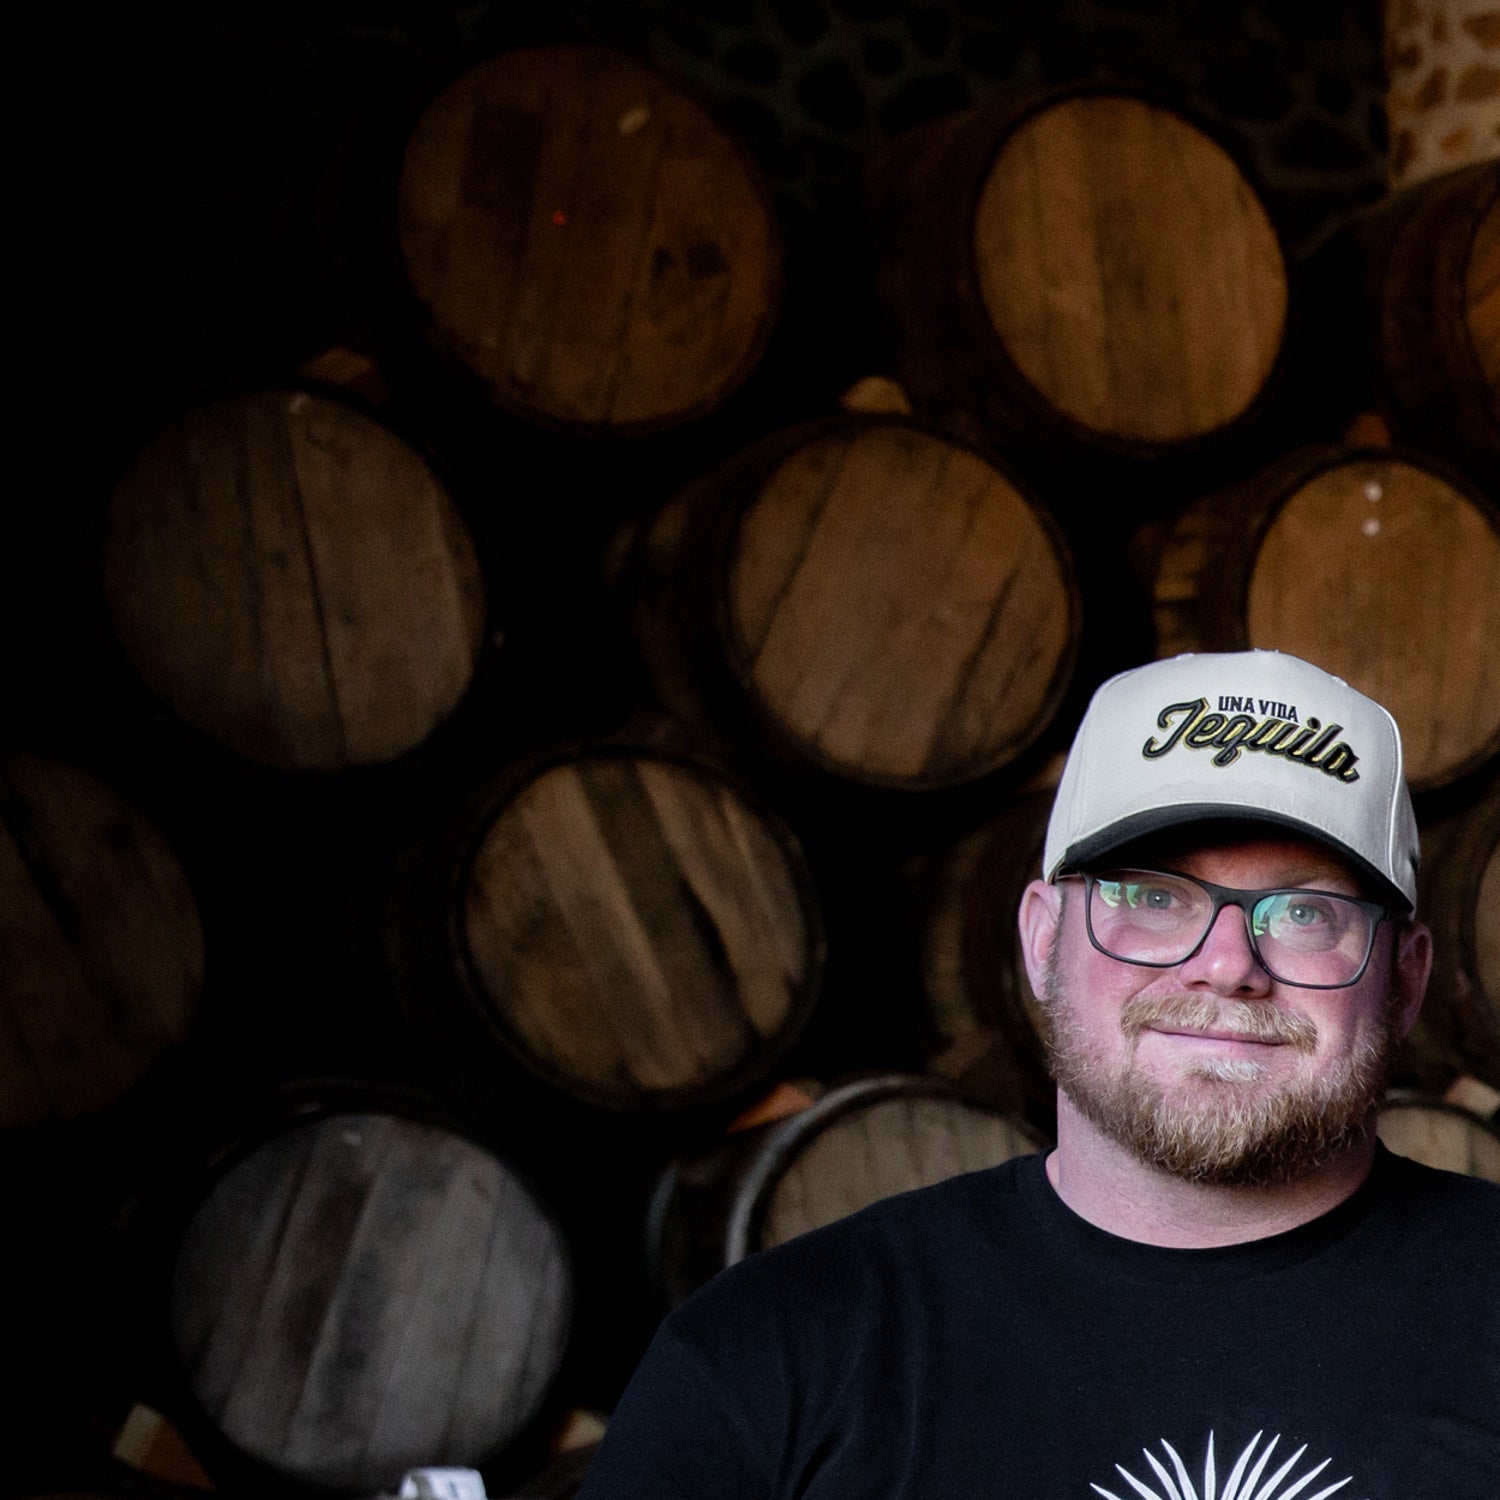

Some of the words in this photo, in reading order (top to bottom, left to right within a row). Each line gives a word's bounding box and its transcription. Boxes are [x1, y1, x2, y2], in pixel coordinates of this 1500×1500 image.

[1218, 696, 1256, 714] UNA
[1258, 699, 1299, 723] VIDA
[1142, 697, 1360, 784] Tequila
